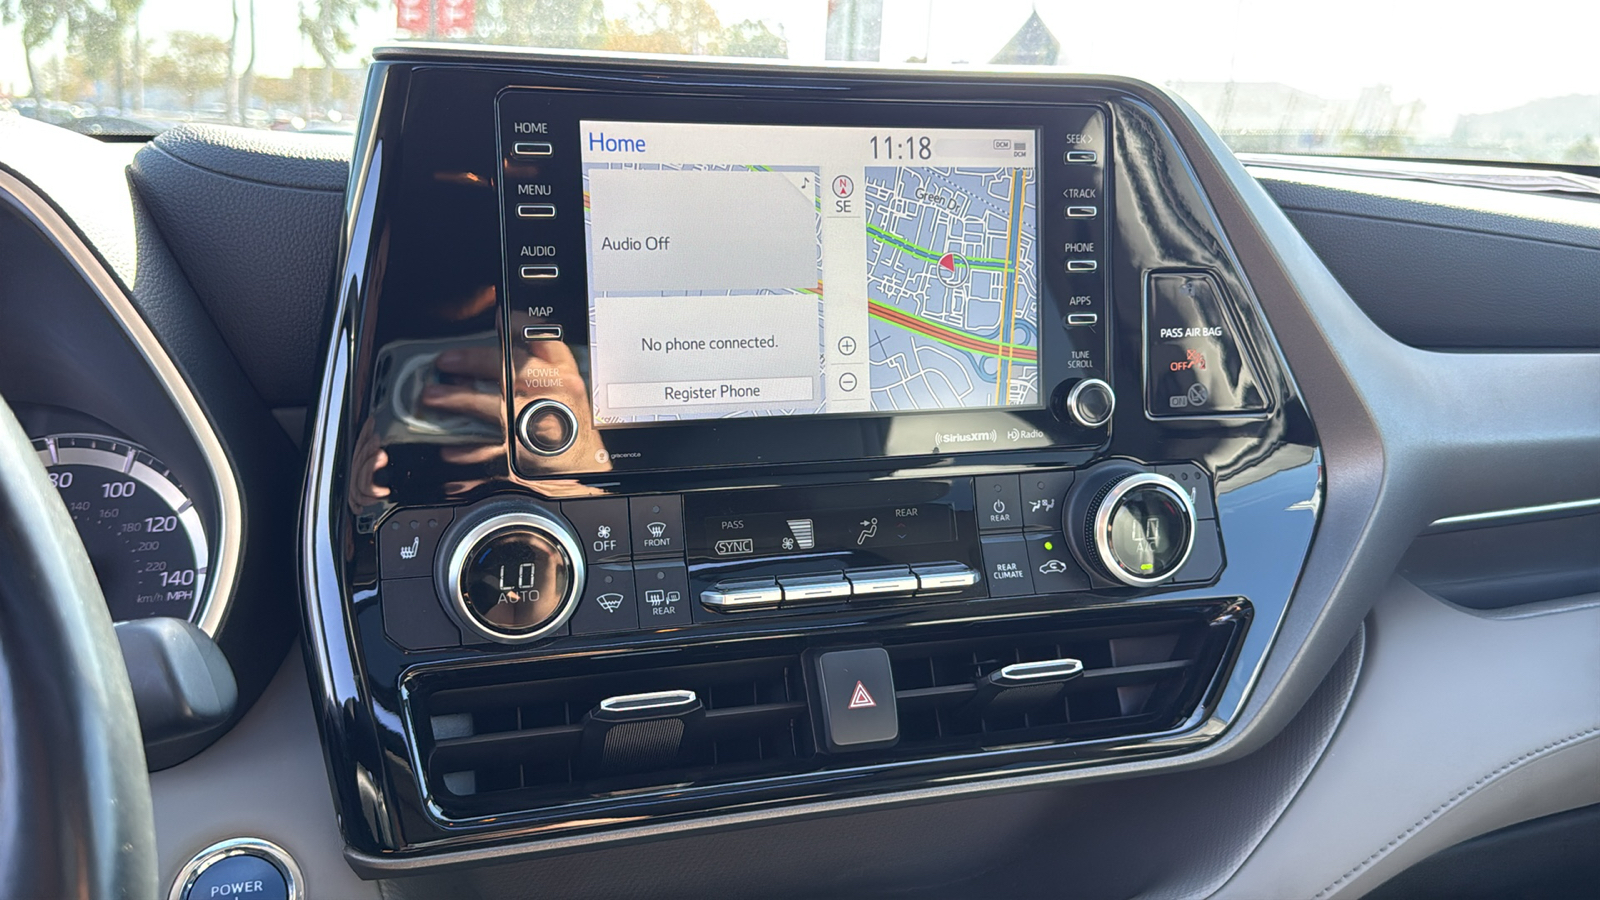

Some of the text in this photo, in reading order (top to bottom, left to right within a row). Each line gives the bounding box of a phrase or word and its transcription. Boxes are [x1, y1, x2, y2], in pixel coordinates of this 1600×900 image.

[514, 122, 548, 134] HOME
[589, 132, 646, 152] Home
[870, 136, 932, 160] 11:18
[840, 178, 847, 186] N
[518, 184, 552, 196] MENU
[915, 188, 961, 212] Green Dr
[836, 201, 851, 212] SE
[602, 236, 670, 250] Audio Off
[1064, 243, 1094, 252] PHONE
[520, 246, 556, 256] AUDIO
[1069, 296, 1091, 306] APPS
[528, 306, 554, 317] MAP
[1160, 327, 1222, 338] PASS AIR BAG
[642, 335, 778, 353] No phone connected.
[1071, 351, 1089, 359] TUNE
[1068, 360, 1093, 368] SCROLL
[1170, 362, 1188, 371] OFF
[527, 368, 560, 377] POWER
[525, 379, 563, 388] VOLUME
[664, 384, 760, 402] Register Phone
[1021, 430, 1044, 438] Radio
[102, 482, 136, 498] 100
[70, 502, 90, 511] 140
[100, 508, 119, 518] 160
[895, 508, 918, 517] REAR
[121, 522, 142, 532] 180
[145, 516, 177, 532] 120
[722, 520, 744, 529] PASS
[138, 541, 159, 551] 200
[593, 540, 616, 552] OFF
[644, 538, 670, 547] FRONT
[719, 541, 750, 552] SYNC
[145, 562, 166, 571] 220
[159, 570, 194, 587] 140
[993, 570, 1024, 579] CLIMATE
[137, 590, 193, 603] km/h MPH
[498, 590, 540, 605] AUTO
[652, 606, 675, 615] REAR
[211, 880, 263, 897] POWER
